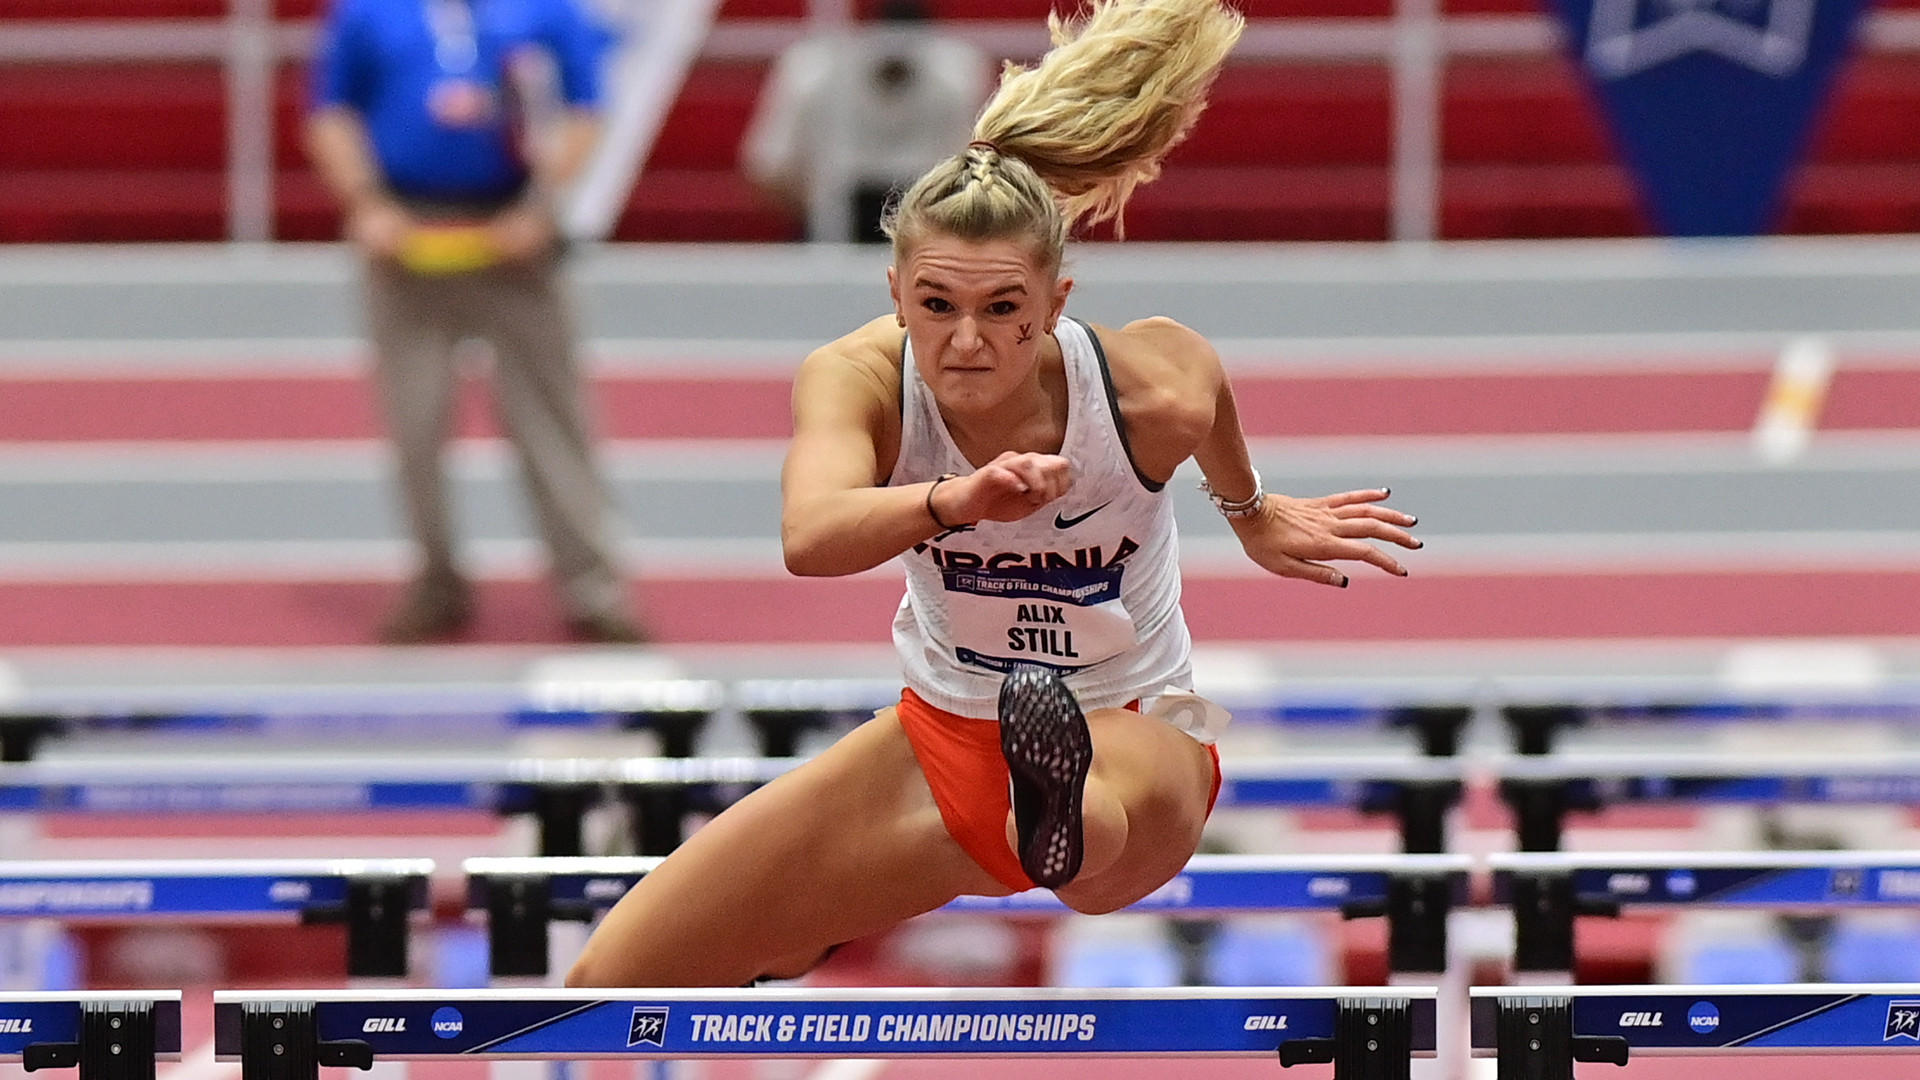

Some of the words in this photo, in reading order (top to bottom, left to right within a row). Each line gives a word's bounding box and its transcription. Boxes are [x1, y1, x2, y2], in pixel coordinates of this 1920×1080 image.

[913, 535, 1140, 569] IRGINIA
[977, 580, 1005, 590] TRACK
[1015, 582, 1040, 590] FIELD
[1016, 604, 1066, 624] ALIX
[1007, 627, 1079, 657] STILL
[362, 1017, 406, 1032] GILL
[434, 1021, 463, 1032] NCAA
[1243, 1015, 1289, 1030] GILL
[1618, 1012, 1663, 1027] GILL
[1690, 1016, 1720, 1027] NCAA
[690, 1014, 772, 1042] TRACK
[777, 1014, 797, 1042] &
[800, 1014, 870, 1042] FIELD
[876, 1014, 1097, 1042] CHAMPIONSHIPS
